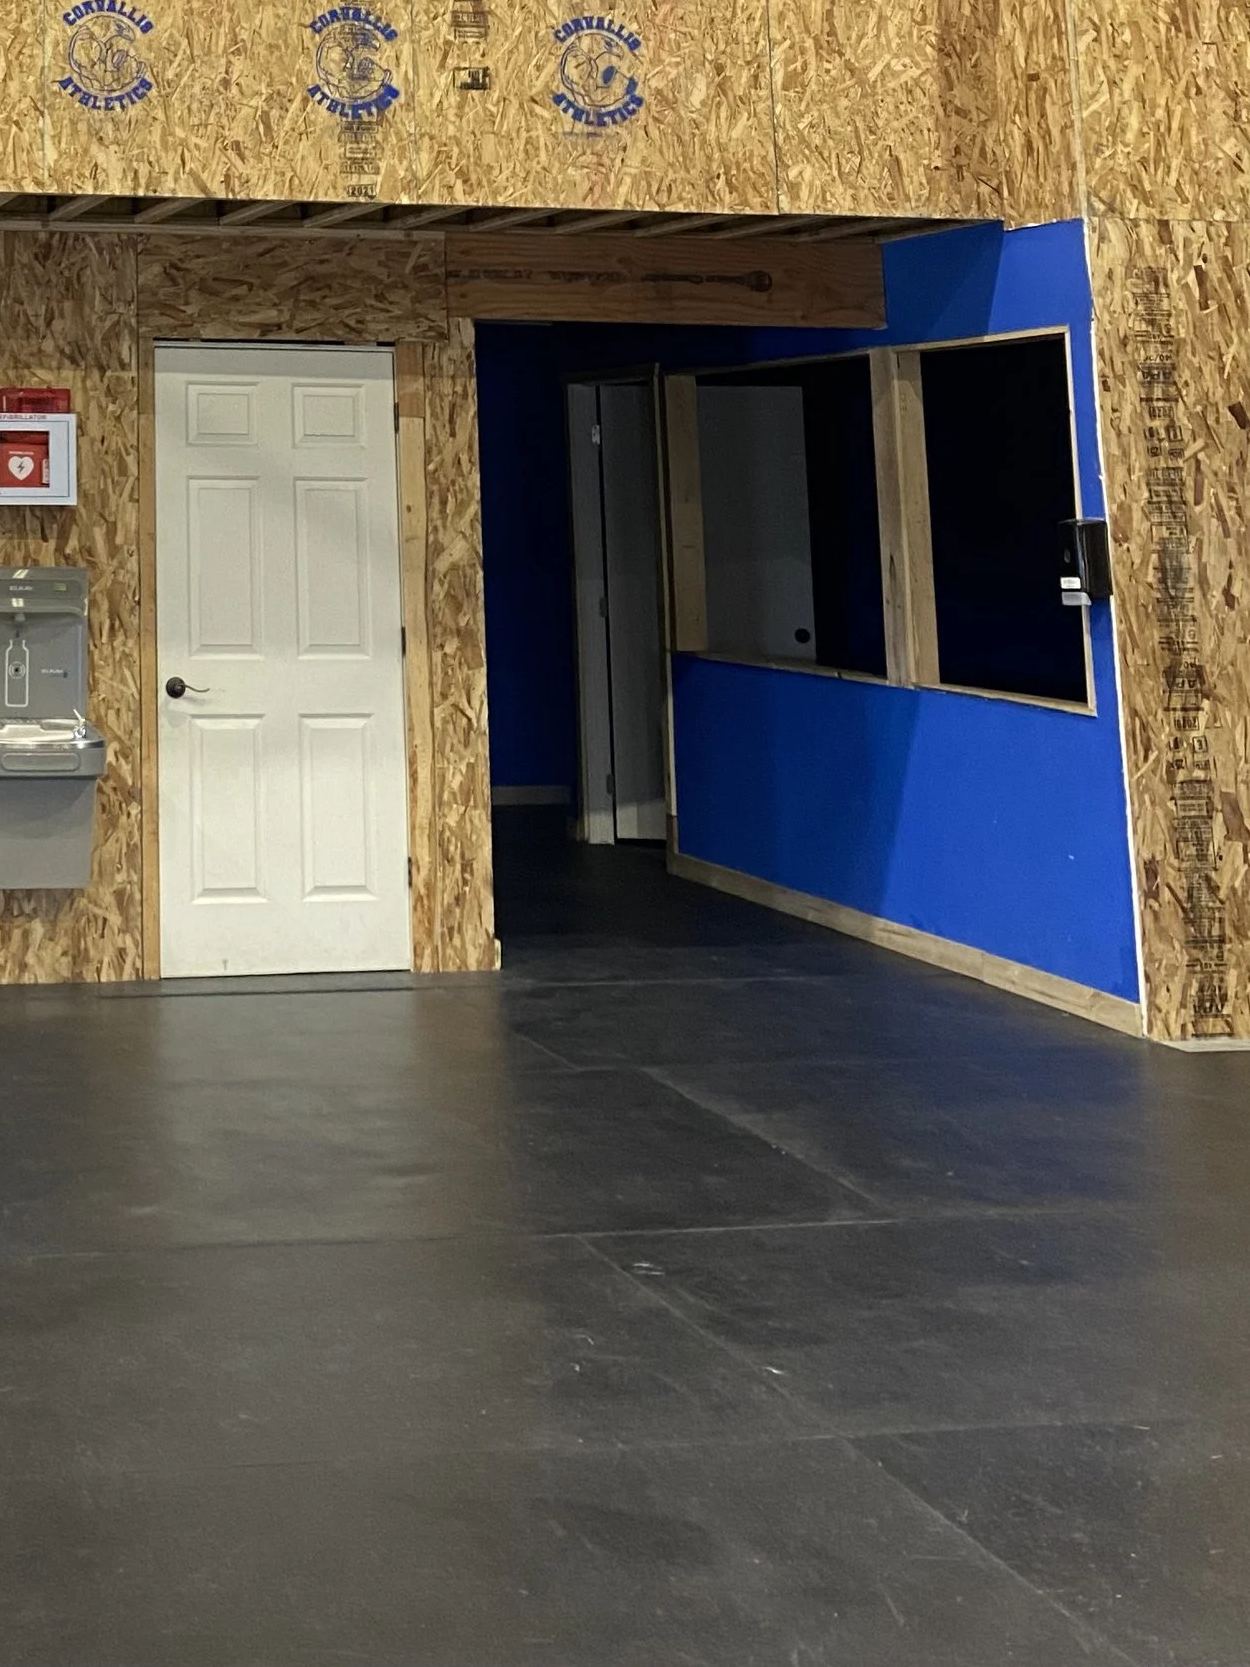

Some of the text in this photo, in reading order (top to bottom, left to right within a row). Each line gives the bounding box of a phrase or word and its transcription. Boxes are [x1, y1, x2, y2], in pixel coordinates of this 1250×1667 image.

[310, 5, 398, 41] CORVALLIS
[554, 16, 641, 51] CORVALLIS
[58, 77, 153, 111] ATHLETICS
[307, 84, 400, 120] ATHLETICS
[552, 94, 644, 126] ATHLETICS
